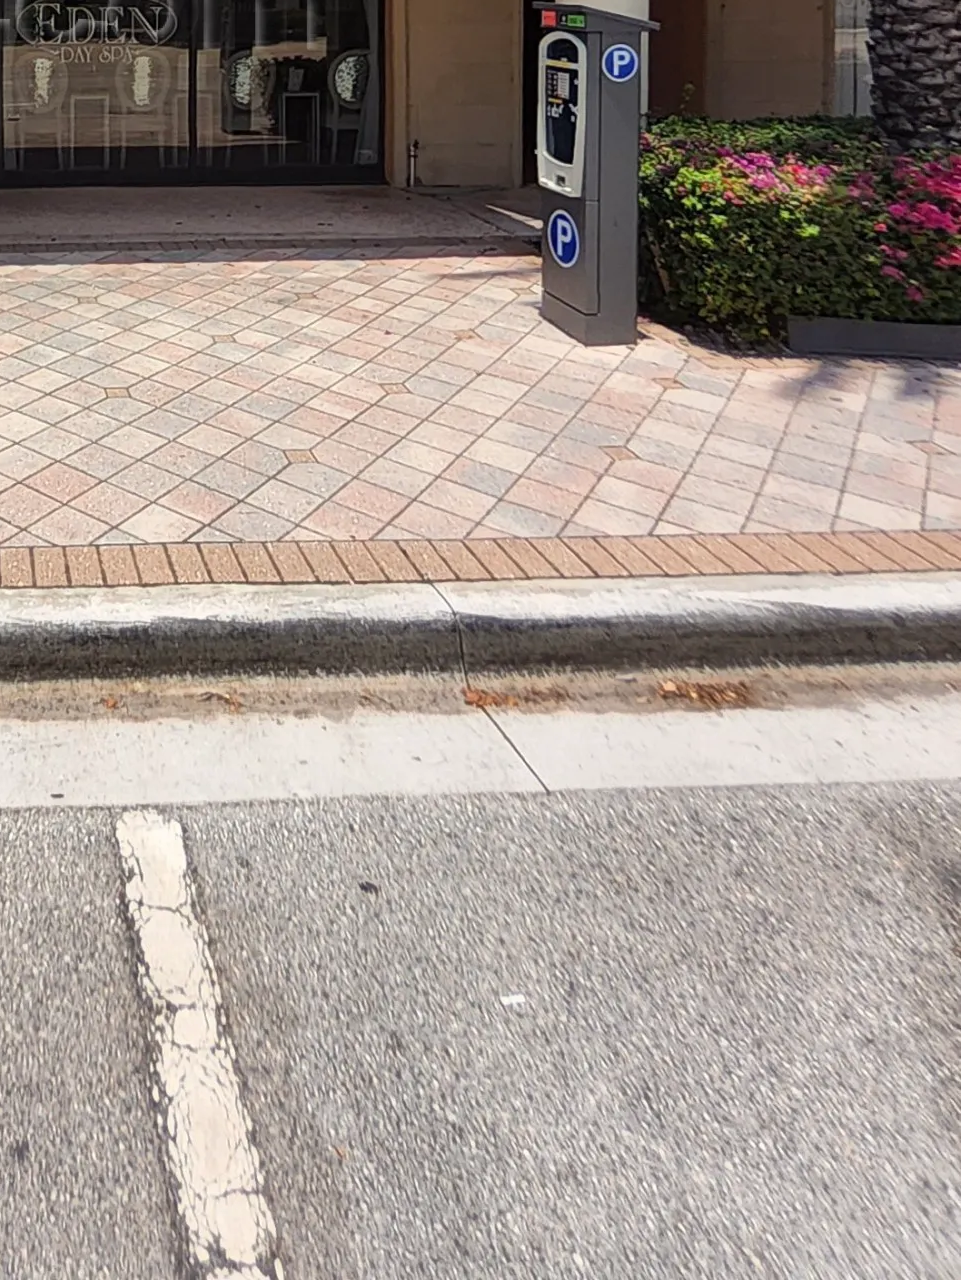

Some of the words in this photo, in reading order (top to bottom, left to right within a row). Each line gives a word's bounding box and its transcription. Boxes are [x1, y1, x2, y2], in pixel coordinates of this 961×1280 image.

[33, 3, 164, 45] EDEN
[60, 46, 95, 64] DAY
[99, 46, 135, 65] SPA
